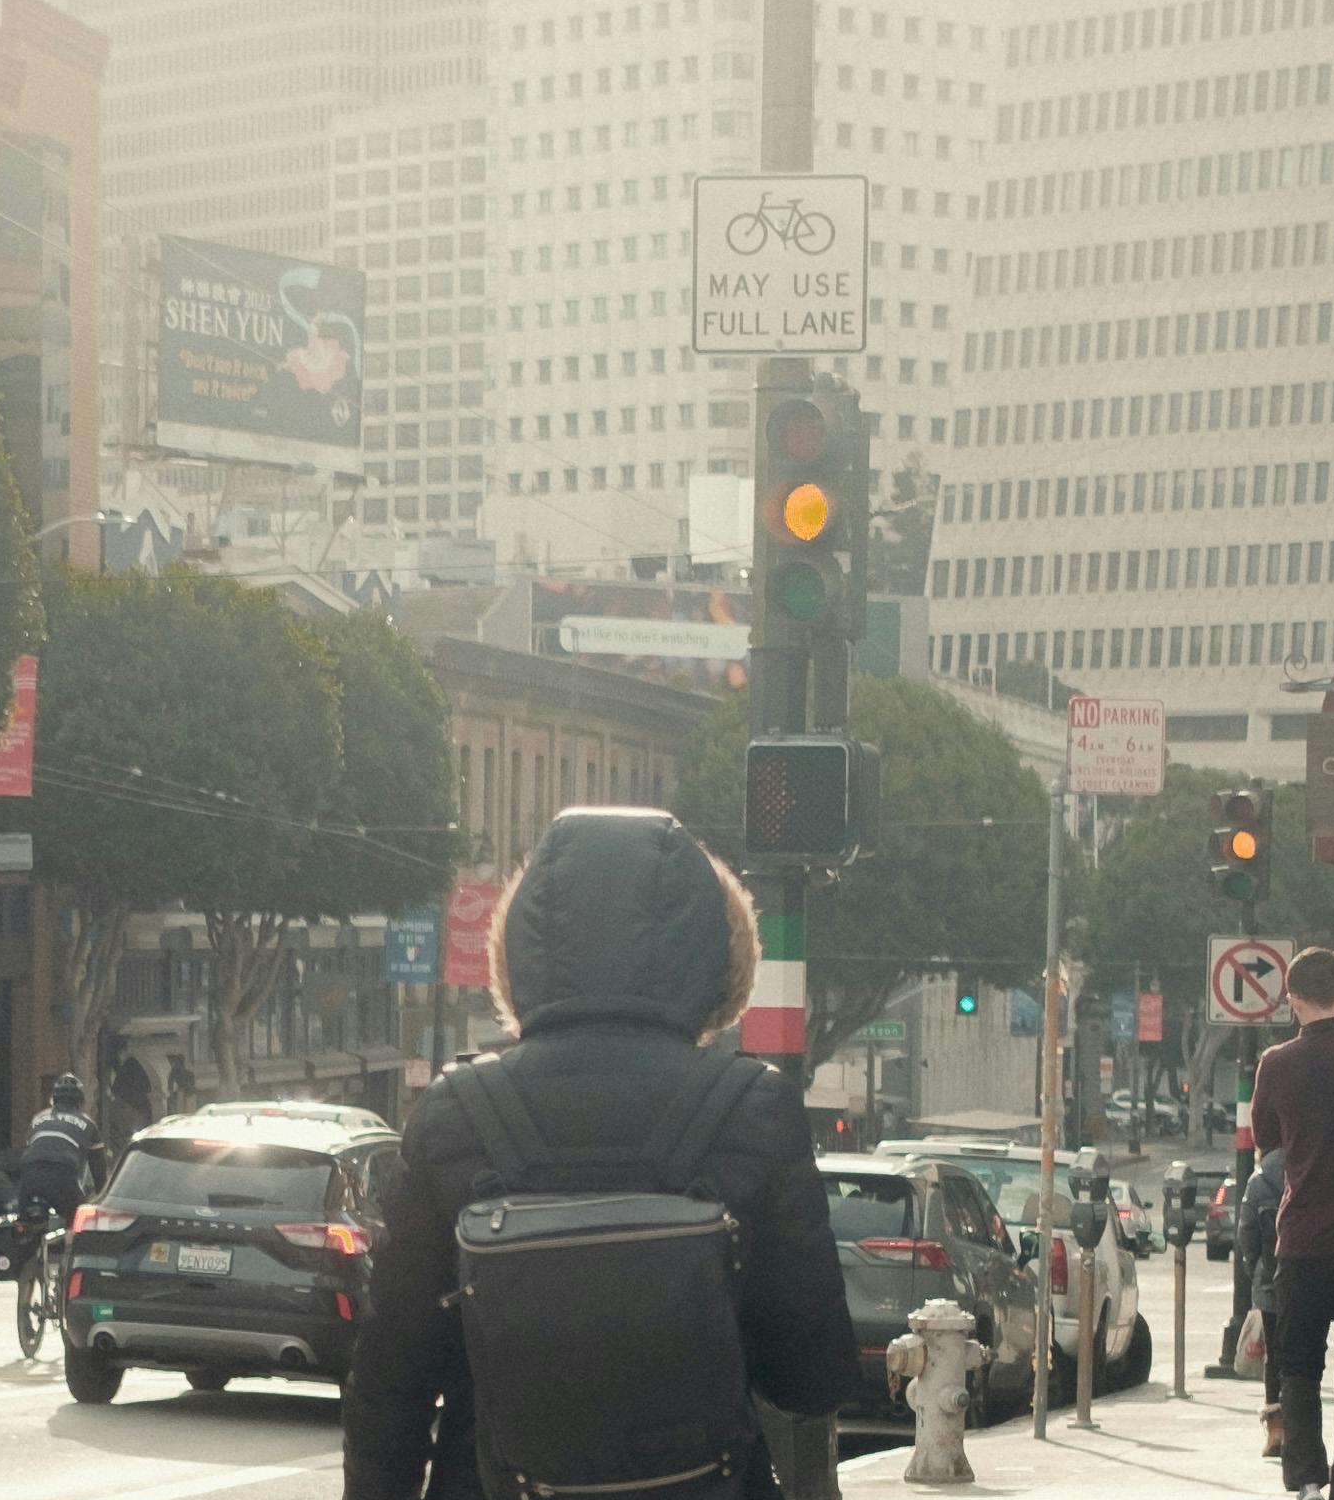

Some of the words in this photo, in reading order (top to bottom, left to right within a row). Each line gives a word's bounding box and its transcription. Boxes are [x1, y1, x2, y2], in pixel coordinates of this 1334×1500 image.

[709, 272, 770, 298] MAY
[793, 272, 851, 298] USE
[165, 297, 230, 338] SHEN
[235, 311, 284, 347] YUN
[703, 311, 770, 336] FULL
[782, 311, 855, 336] LANE
[1074, 701, 1099, 726] NO
[1103, 706, 1160, 727] PARKING
